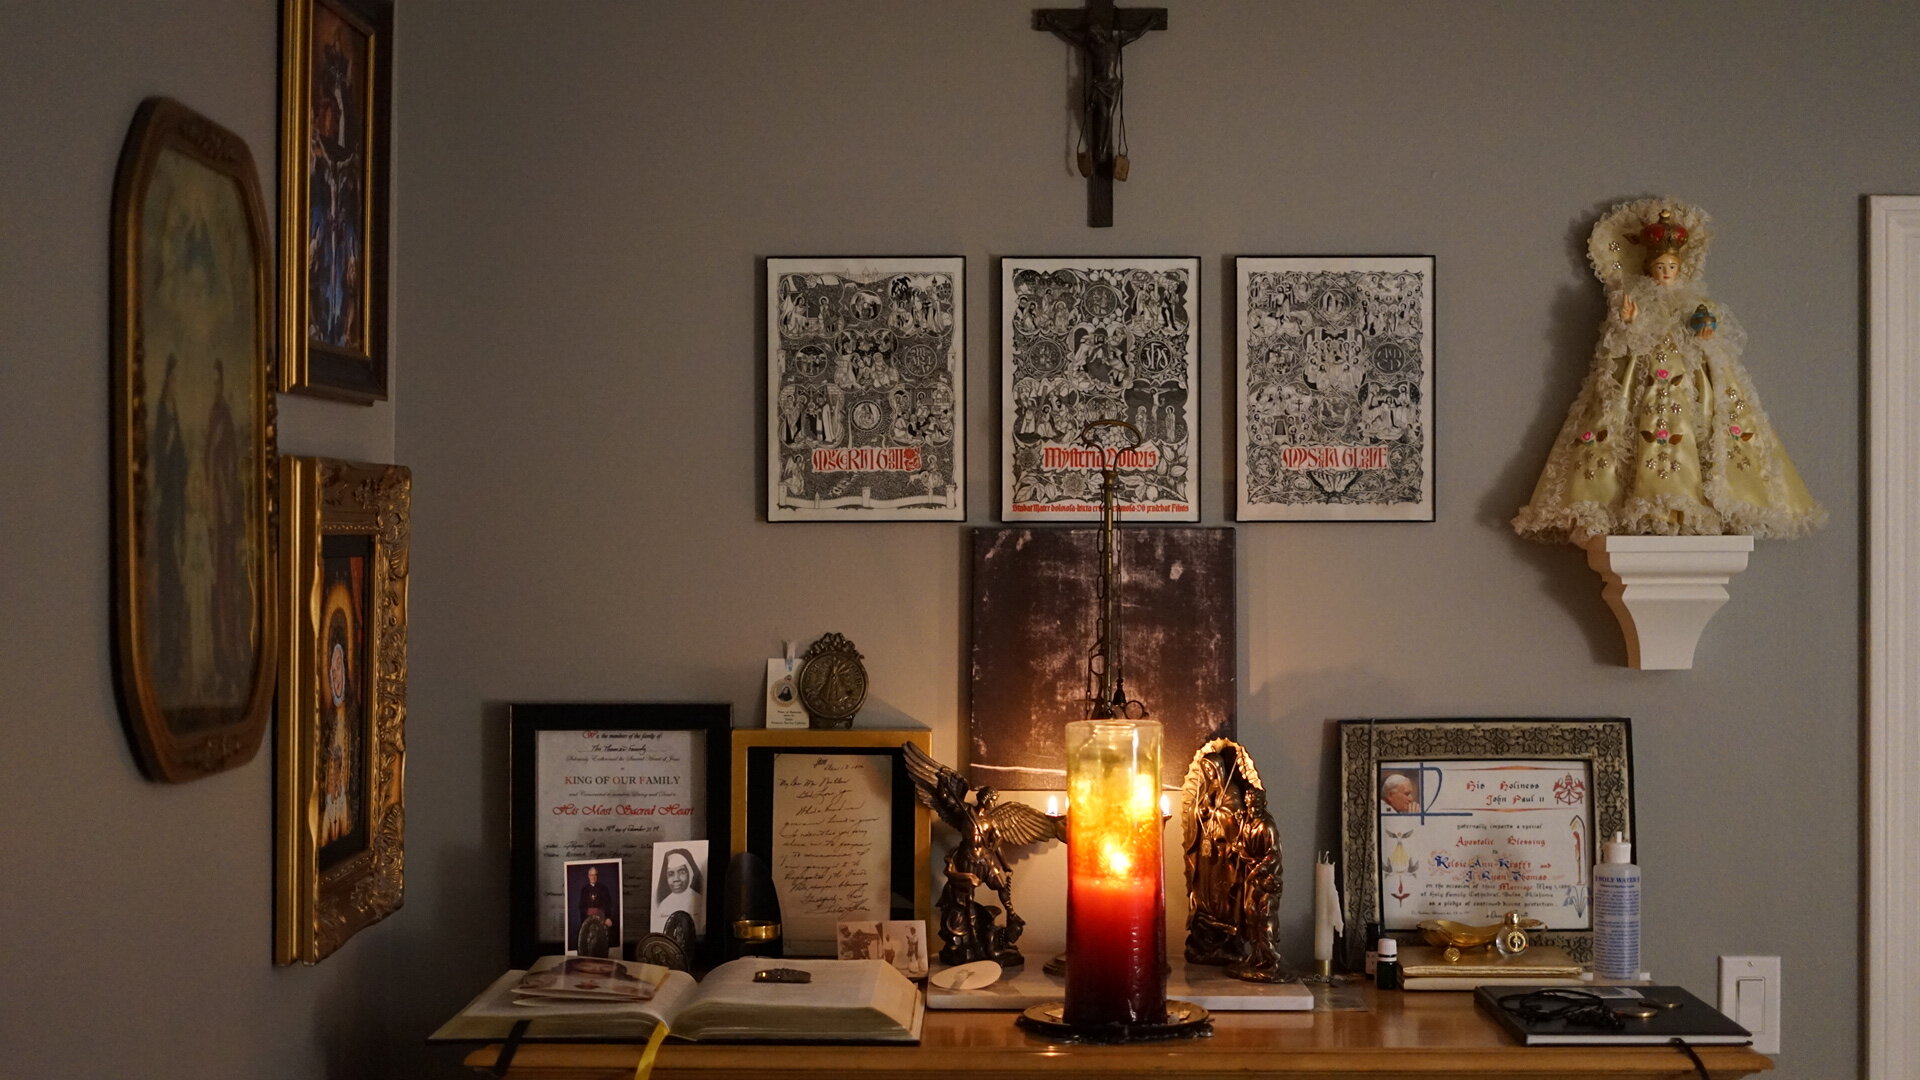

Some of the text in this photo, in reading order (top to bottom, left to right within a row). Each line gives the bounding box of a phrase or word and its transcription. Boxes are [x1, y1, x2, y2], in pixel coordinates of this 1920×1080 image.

[564, 776, 681, 785] KING OF OUR FAMILY
[1466, 780, 1540, 792] His Holiness
[1486, 794, 1507, 806] John
[1512, 794, 1535, 805] Paul
[552, 803, 695, 816] His Most Sacred Heart
[1455, 835, 1546, 848] Apostolic Blessing
[1511, 870, 1548, 882] Thomas
